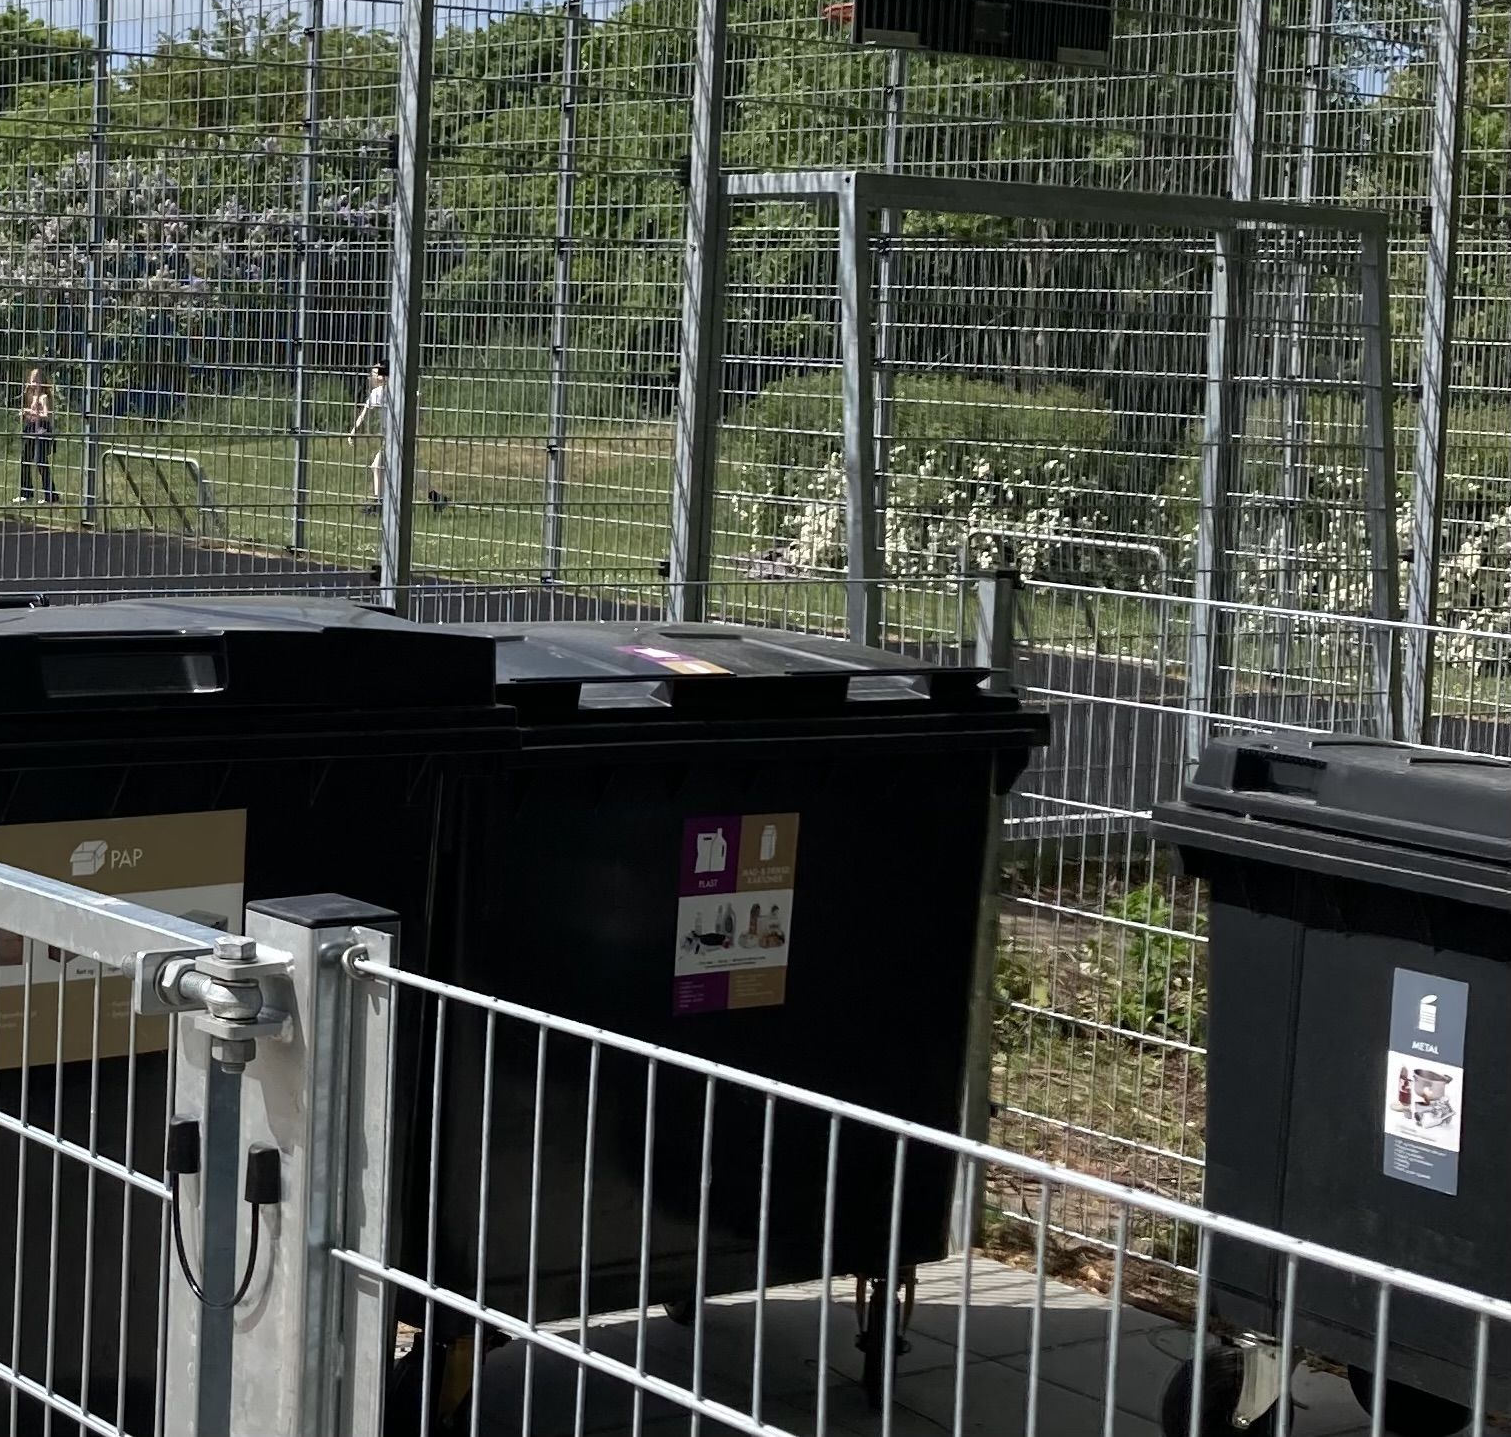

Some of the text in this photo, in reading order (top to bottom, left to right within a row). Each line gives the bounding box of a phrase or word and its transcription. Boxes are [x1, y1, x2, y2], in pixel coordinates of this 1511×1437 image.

[111, 848, 143, 869] PAP
[698, 879, 718, 888] PLAST
[1411, 1041, 1439, 1055] METAL
